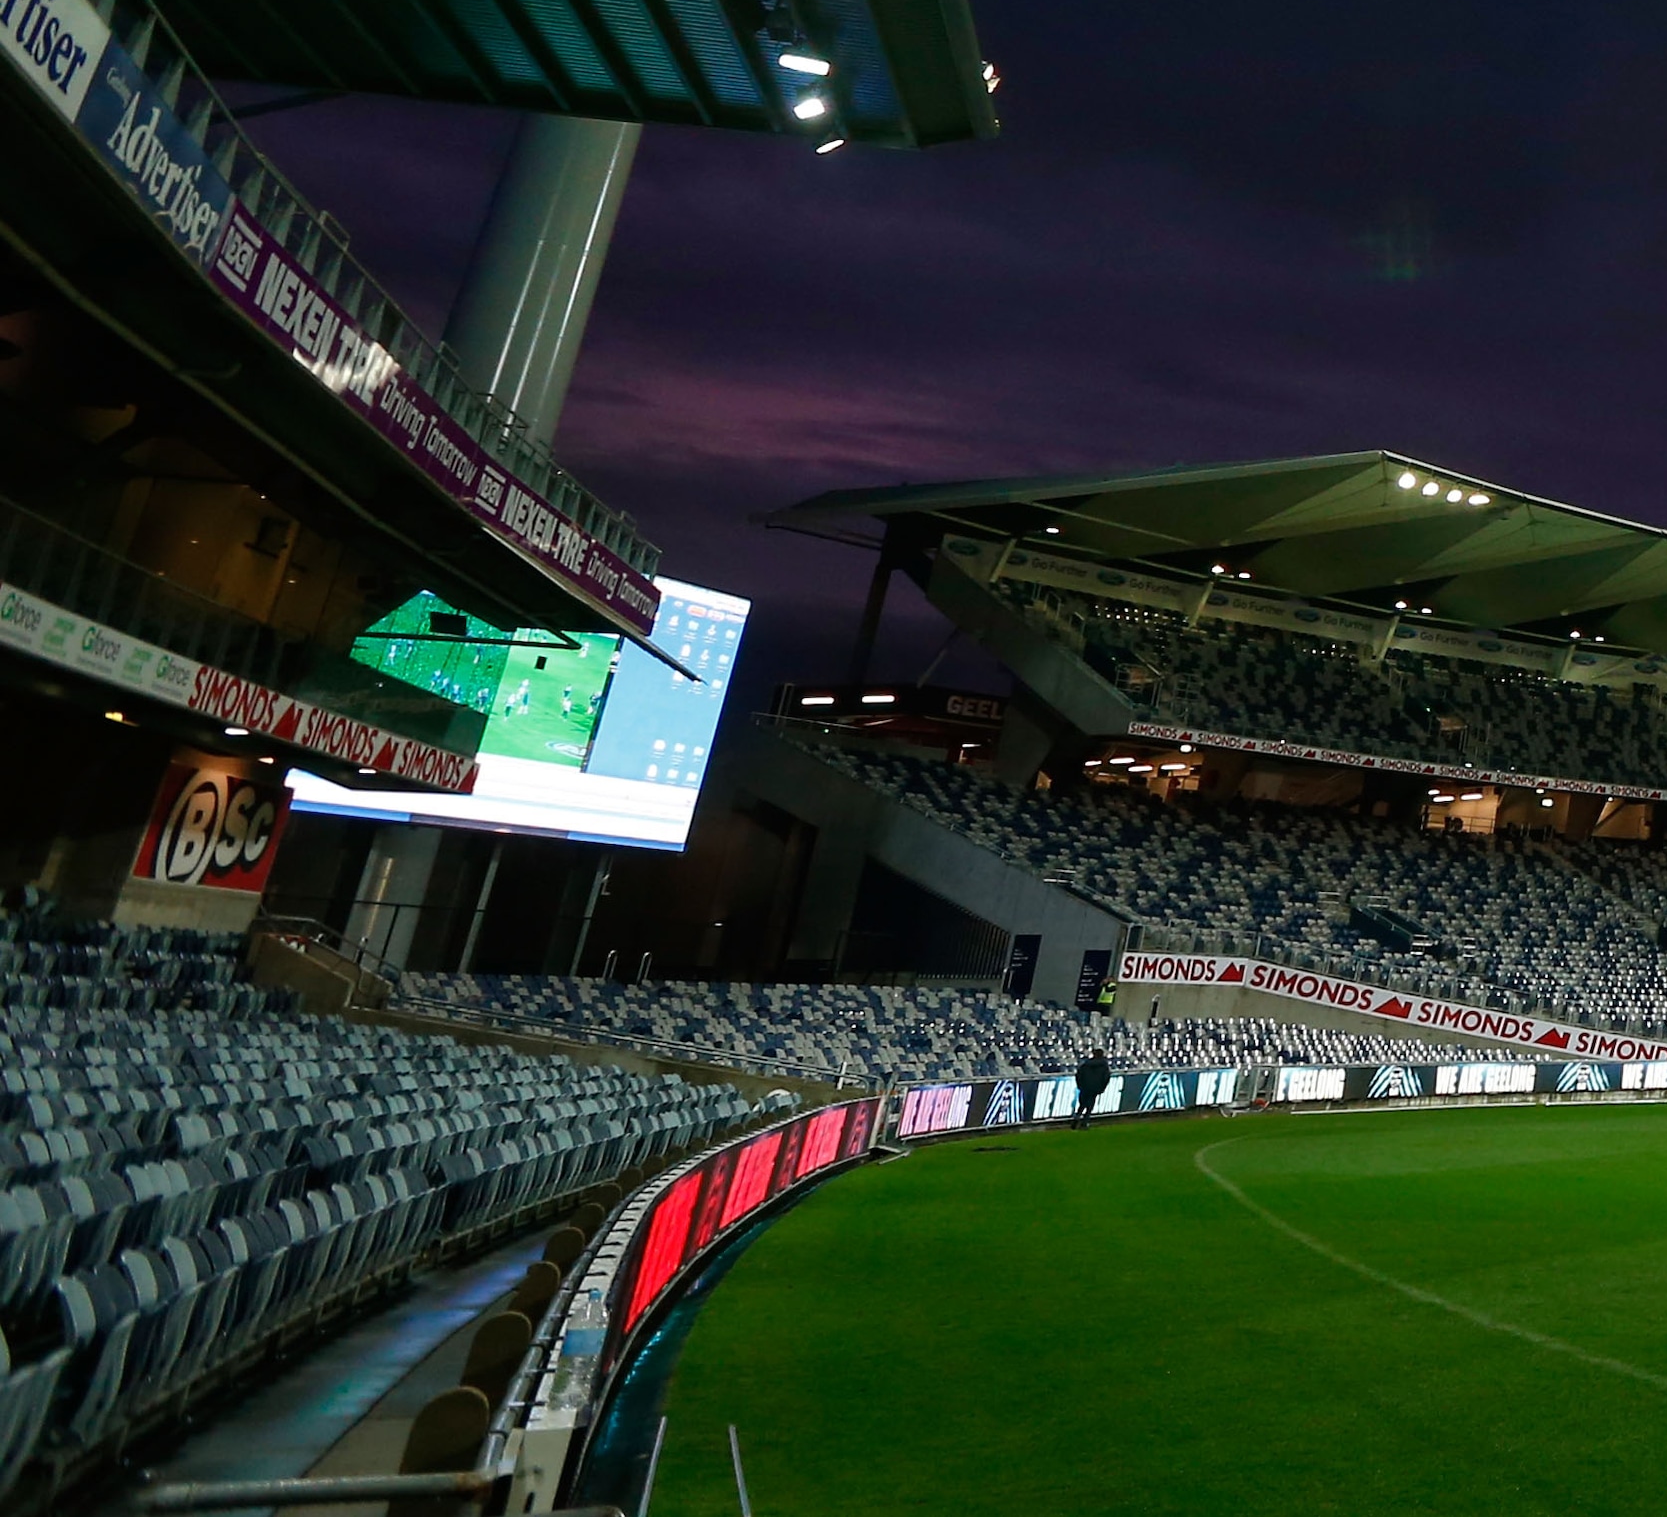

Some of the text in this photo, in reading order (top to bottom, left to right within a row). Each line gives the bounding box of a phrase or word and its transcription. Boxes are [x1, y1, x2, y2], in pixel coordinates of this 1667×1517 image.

[253, 252, 341, 365] NEXEN
[380, 377, 425, 449] Driving
[422, 414, 478, 486] Tomorrow
[501, 484, 558, 553] NEXEN
[553, 525, 589, 575] TIRE
[586, 551, 618, 600] Driving
[618, 572, 658, 617] Tomorrow
[188, 665, 280, 733] SIMONDS
[302, 708, 379, 765] SIMONDS
[399, 741, 465, 790] SIMONDS
[1130, 722, 1649, 799] SIMONDS SIMONDS SIMONDS SIMONDS SIMONDS SIMONDS SIMONDS SIMONDS SIMONDS
[1121, 956, 1216, 982] SIMONDS
[1250, 964, 1374, 1011] SIMONDS
[1417, 1001, 1534, 1043] SIMONDS
[1289, 1067, 1346, 1102] GEELONG
[1435, 1063, 1536, 1095] WE ARE GEELONG
[1621, 1063, 1645, 1090] WE
